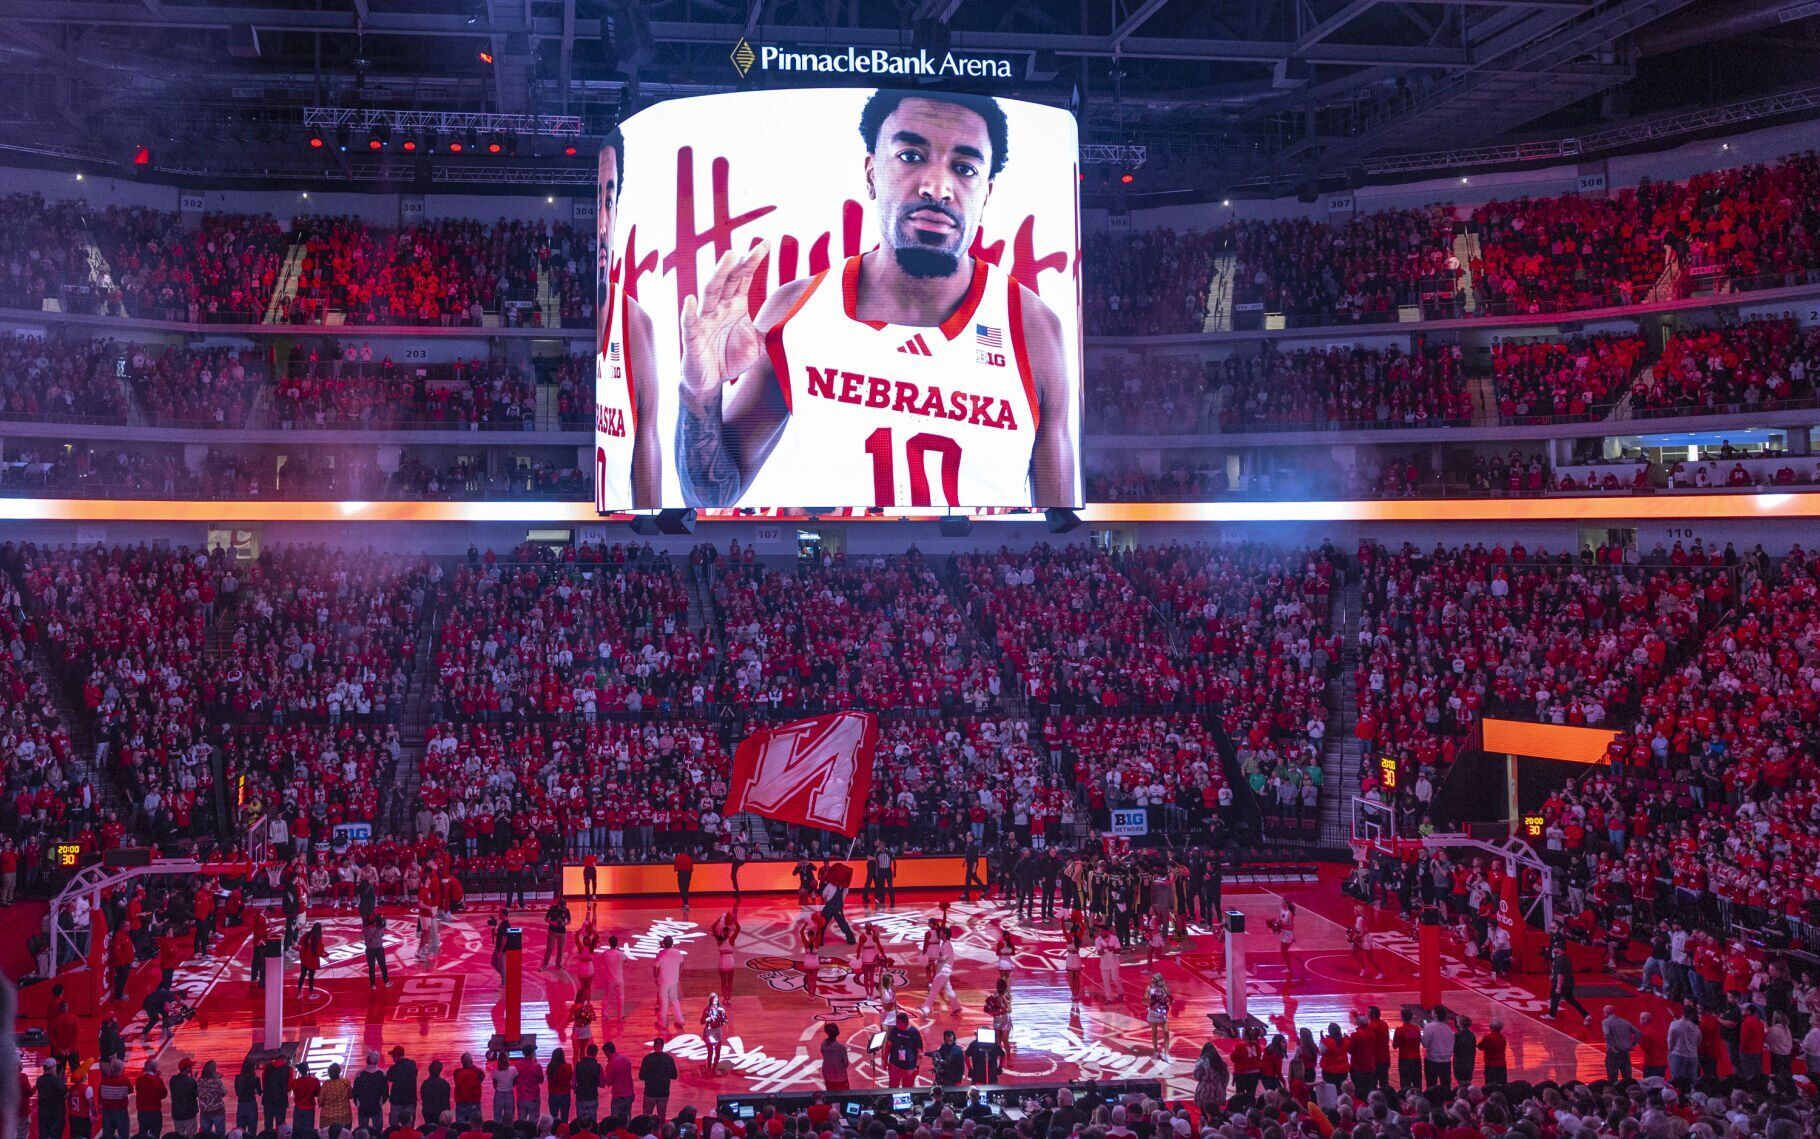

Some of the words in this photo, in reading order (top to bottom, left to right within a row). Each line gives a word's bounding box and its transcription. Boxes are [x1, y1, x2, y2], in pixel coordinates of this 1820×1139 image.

[761, 46, 936, 76] PinnacleBank
[939, 52, 1012, 78] Arena
[1580, 178, 1604, 188] 308
[183, 199, 203, 208] 302
[403, 203, 422, 212] 303
[1330, 199, 1350, 209] 307
[575, 207, 594, 215] 304
[406, 350, 427, 358] 203
[805, 365, 1018, 431] NEBRASKA
[864, 427, 963, 508] 10
[758, 530, 778, 539] 107
[1666, 528, 1693, 538] 110
[1384, 769, 1396, 787] 30
[1525, 817, 1544, 825] 20:00
[1529, 826, 1541, 835] 30
[58, 845, 81, 854] 20:00
[63, 854, 76, 865] 30
